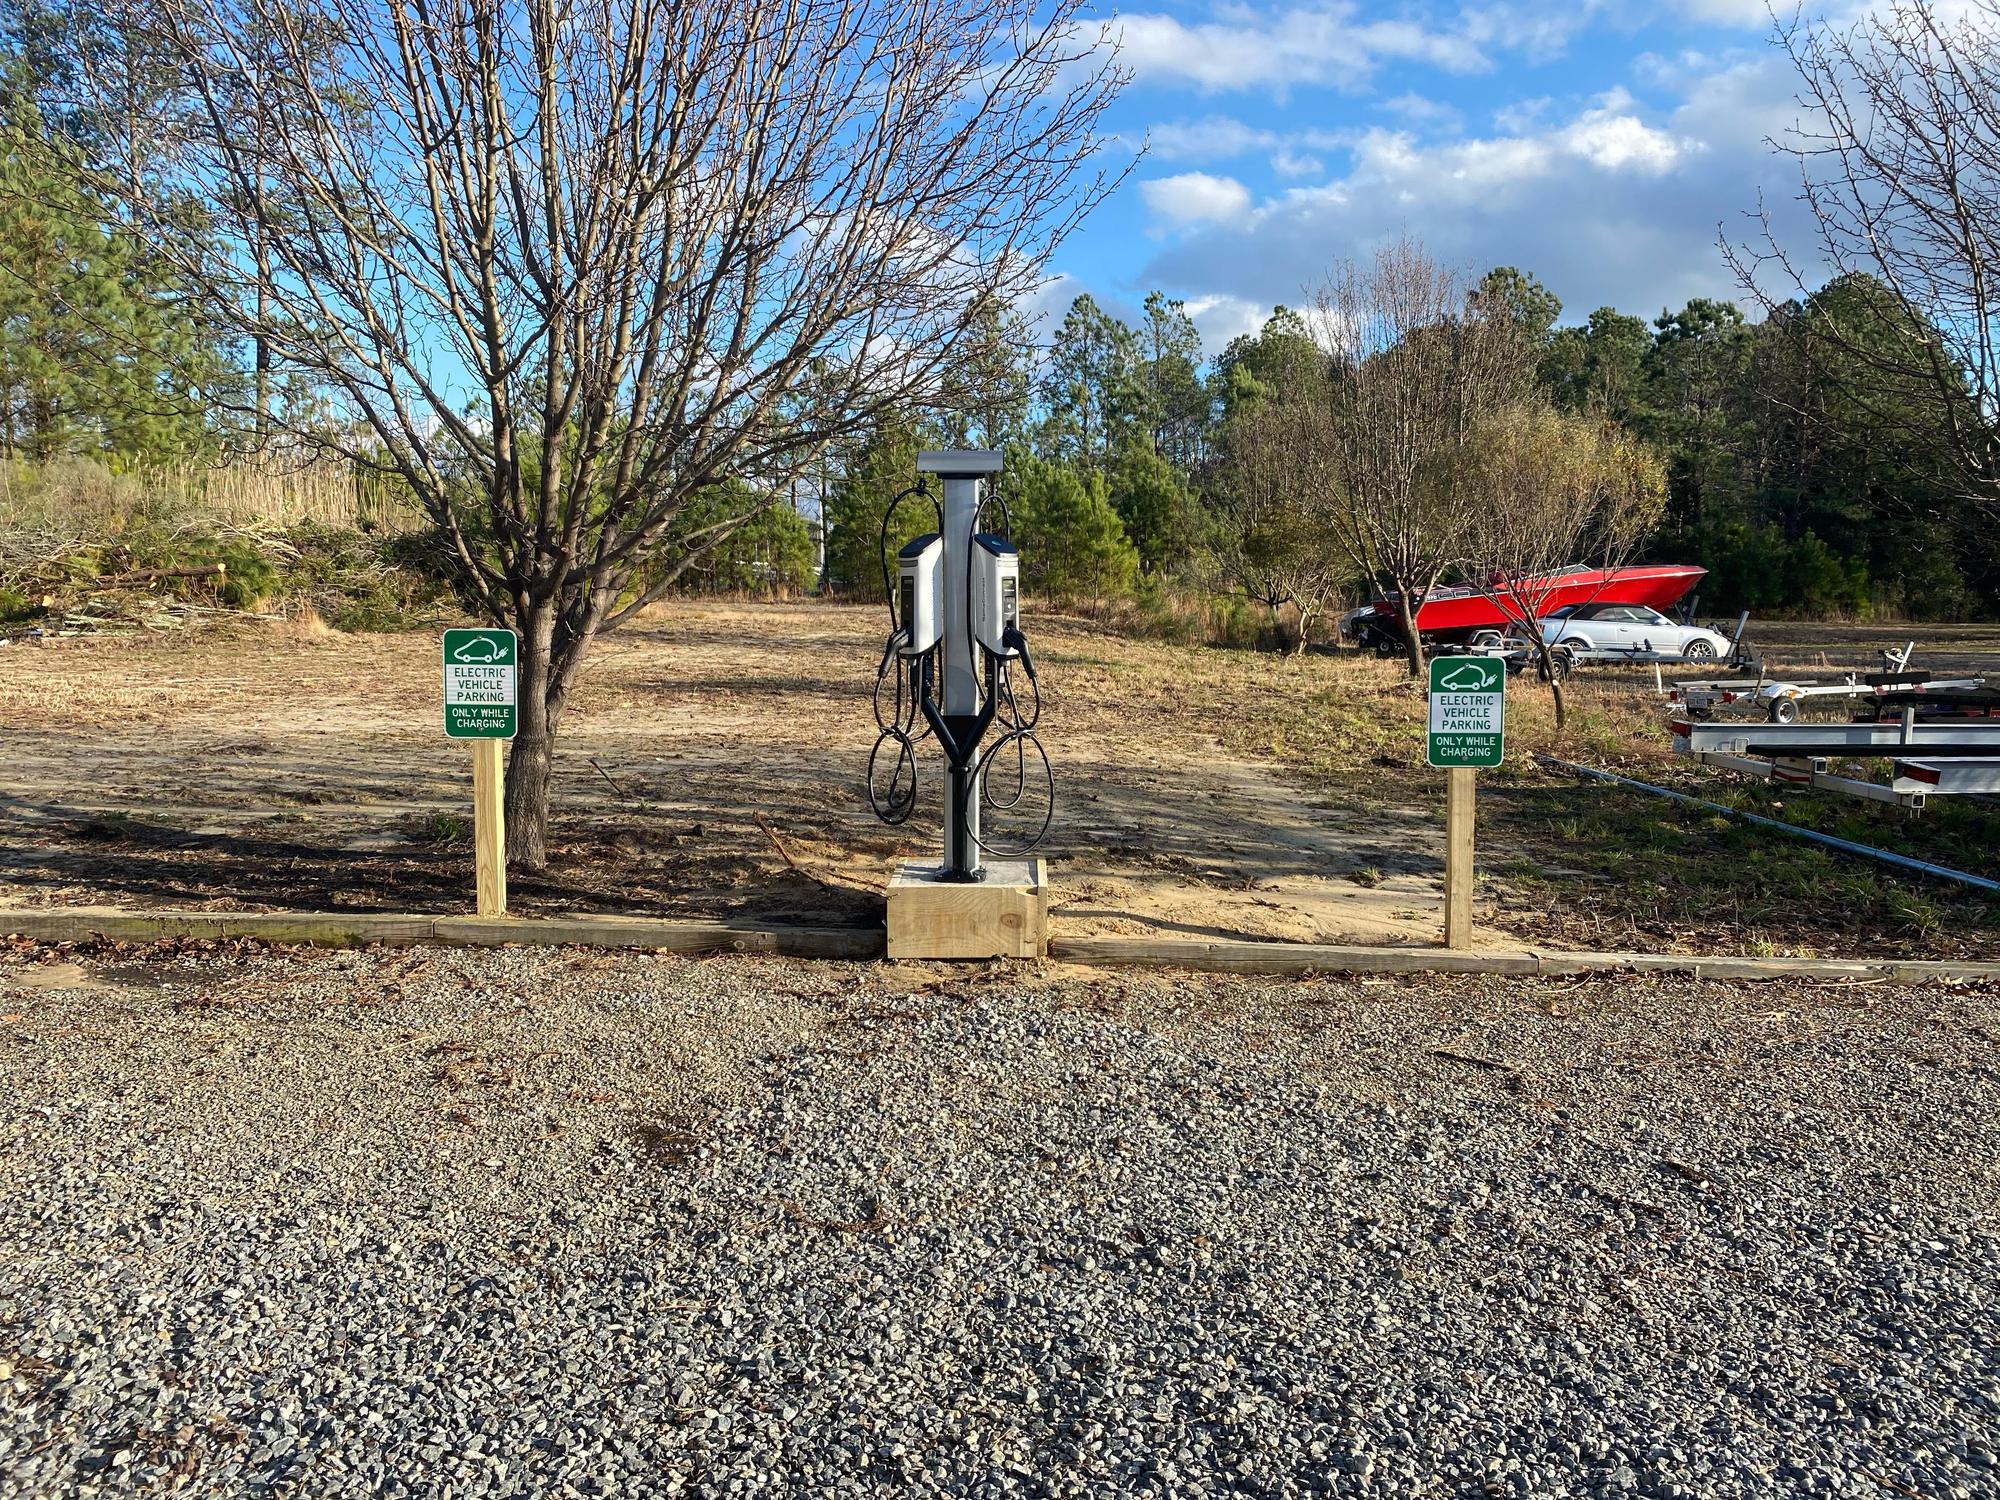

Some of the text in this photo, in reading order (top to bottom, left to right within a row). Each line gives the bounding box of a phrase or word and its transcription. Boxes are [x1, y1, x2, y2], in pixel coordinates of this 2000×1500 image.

[454, 667, 506, 678] ELECTRIC
[458, 680, 503, 690] VEHICLE
[457, 692, 504, 702] PARKING
[1440, 695, 1494, 706] ELECTRIC
[452, 708, 509, 718] ONLY WHILE
[1443, 708, 1490, 718] VEHICLE
[457, 719, 505, 729] CHARGING
[1442, 720, 1491, 730] PARKING
[1436, 736, 1496, 746] ONLY WHILE
[1440, 747, 1491, 757] CHARGING
